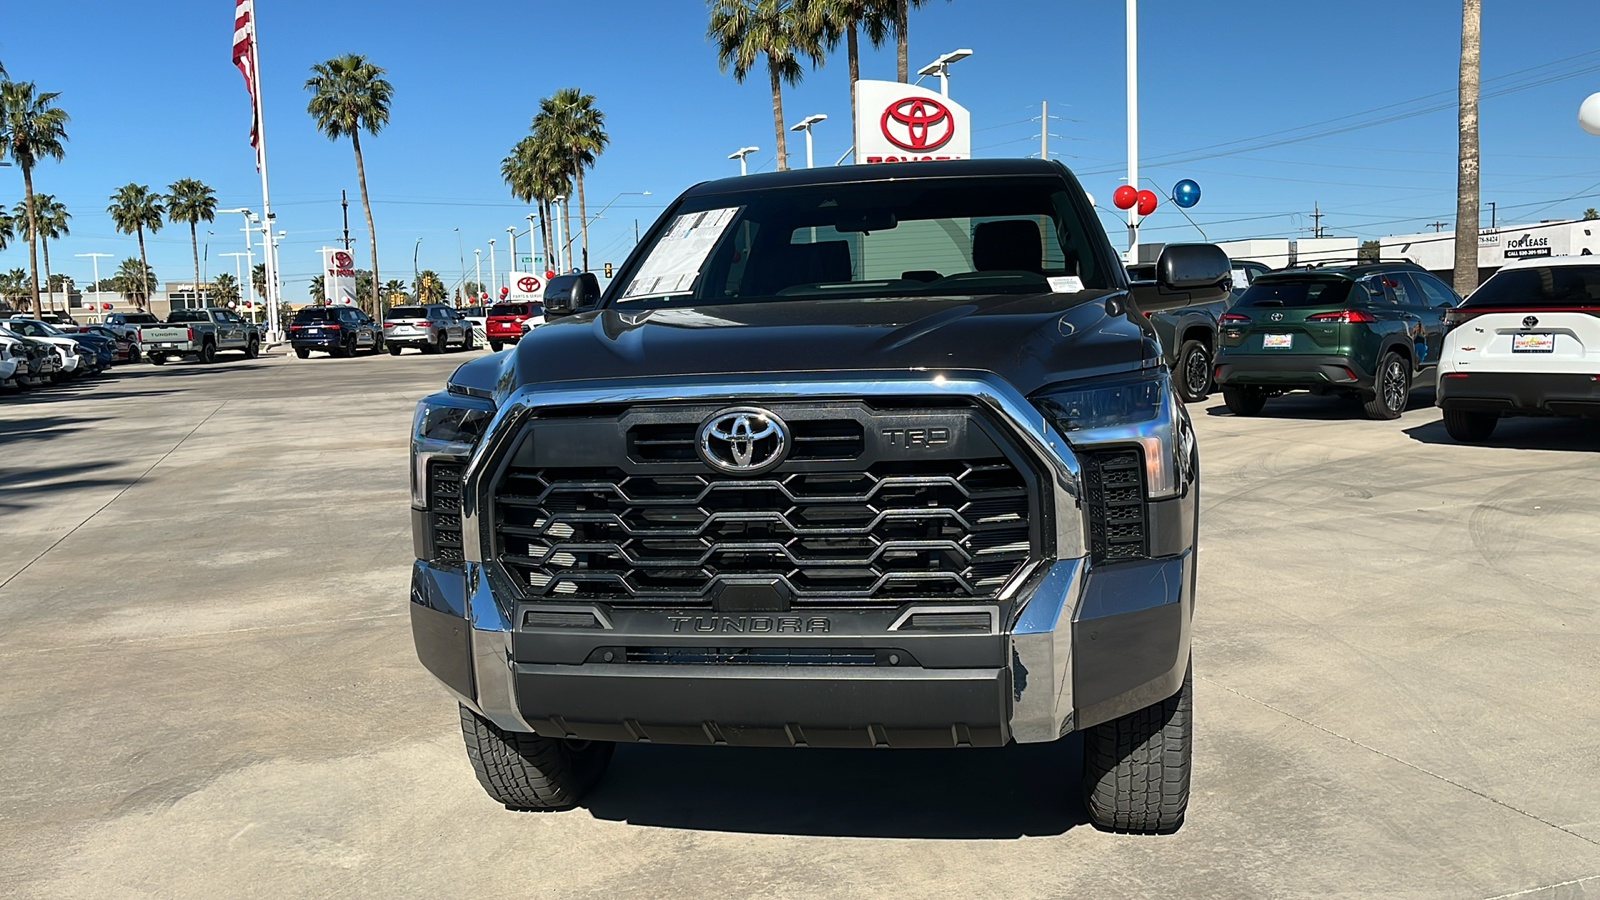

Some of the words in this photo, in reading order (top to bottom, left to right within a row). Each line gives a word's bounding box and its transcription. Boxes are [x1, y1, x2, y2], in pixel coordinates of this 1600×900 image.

[1507, 240, 1523, 248] FOR
[1525, 237, 1548, 247] LEASE
[881, 428, 950, 449] TRD
[665, 616, 831, 633] TUNDRA
